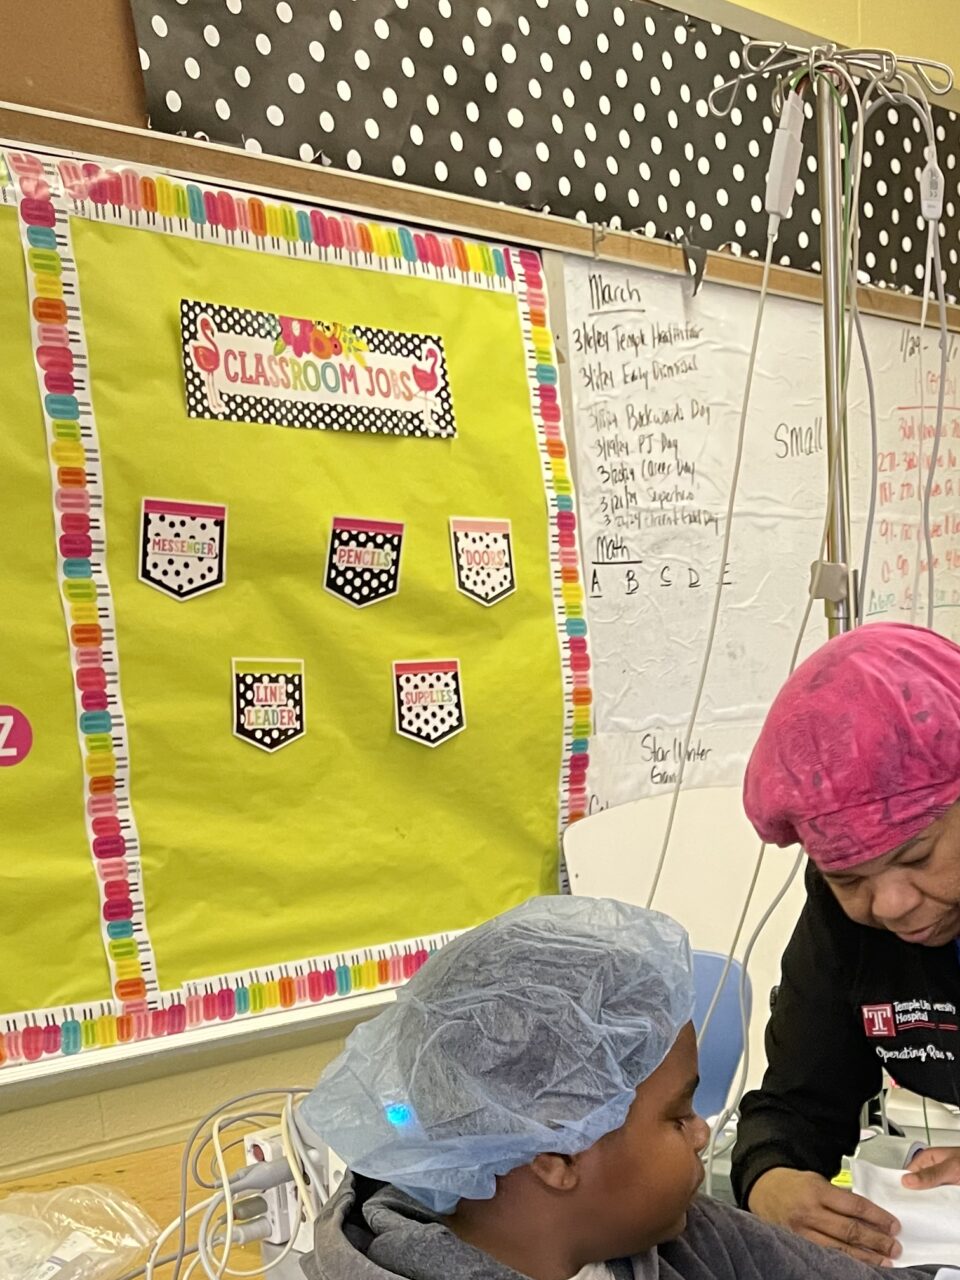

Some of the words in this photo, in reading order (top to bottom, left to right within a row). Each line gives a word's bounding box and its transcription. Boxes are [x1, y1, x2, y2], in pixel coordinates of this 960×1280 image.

[588, 274, 641, 310] March
[224, 349, 360, 395] CLASSROOM
[365, 366, 414, 402] JOBS
[691, 399, 710, 426] Day
[774, 416, 823, 459] Small
[152, 538, 214, 556] MESSENGER
[337, 547, 391, 568] PENCILS
[465, 549, 504, 567] DOORS
[591, 569, 601, 593] A
[626, 569, 639, 593] B
[660, 566, 672, 583] C
[688, 567, 701, 586] D
[255, 685, 285, 704] LINE
[405, 689, 453, 705] SUPPLIES
[246, 708, 295, 727] LEADER
[641, 733, 671, 762] Star
[893, 999, 920, 1013] Temple
[920, 999, 956, 1015] Unversity
[895, 1011, 929, 1024] Hospital
[876, 1046, 927, 1063] Operating
